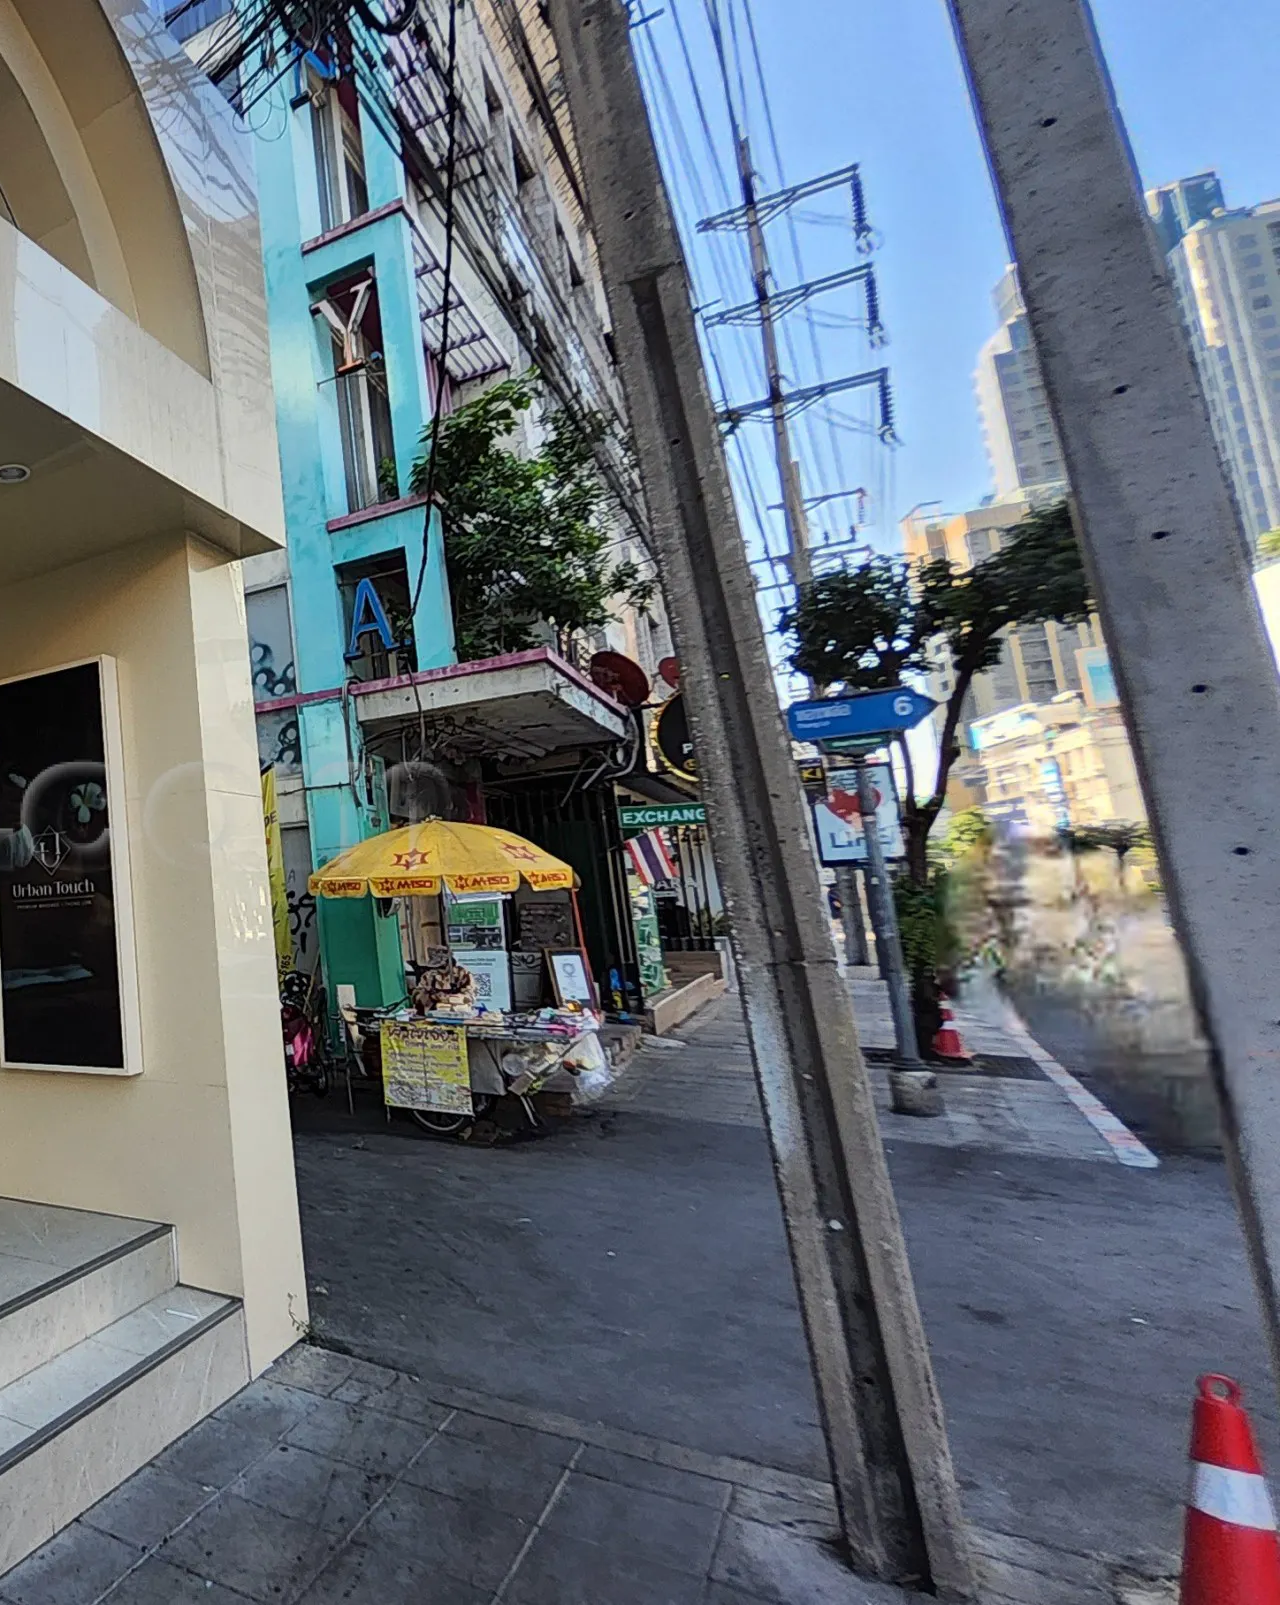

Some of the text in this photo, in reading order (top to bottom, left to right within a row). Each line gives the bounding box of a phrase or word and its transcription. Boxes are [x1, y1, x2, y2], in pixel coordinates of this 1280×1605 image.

[343, 577, 401, 658] A
[893, 695, 914, 717] 6
[12, 878, 95, 898] Urban Touch
